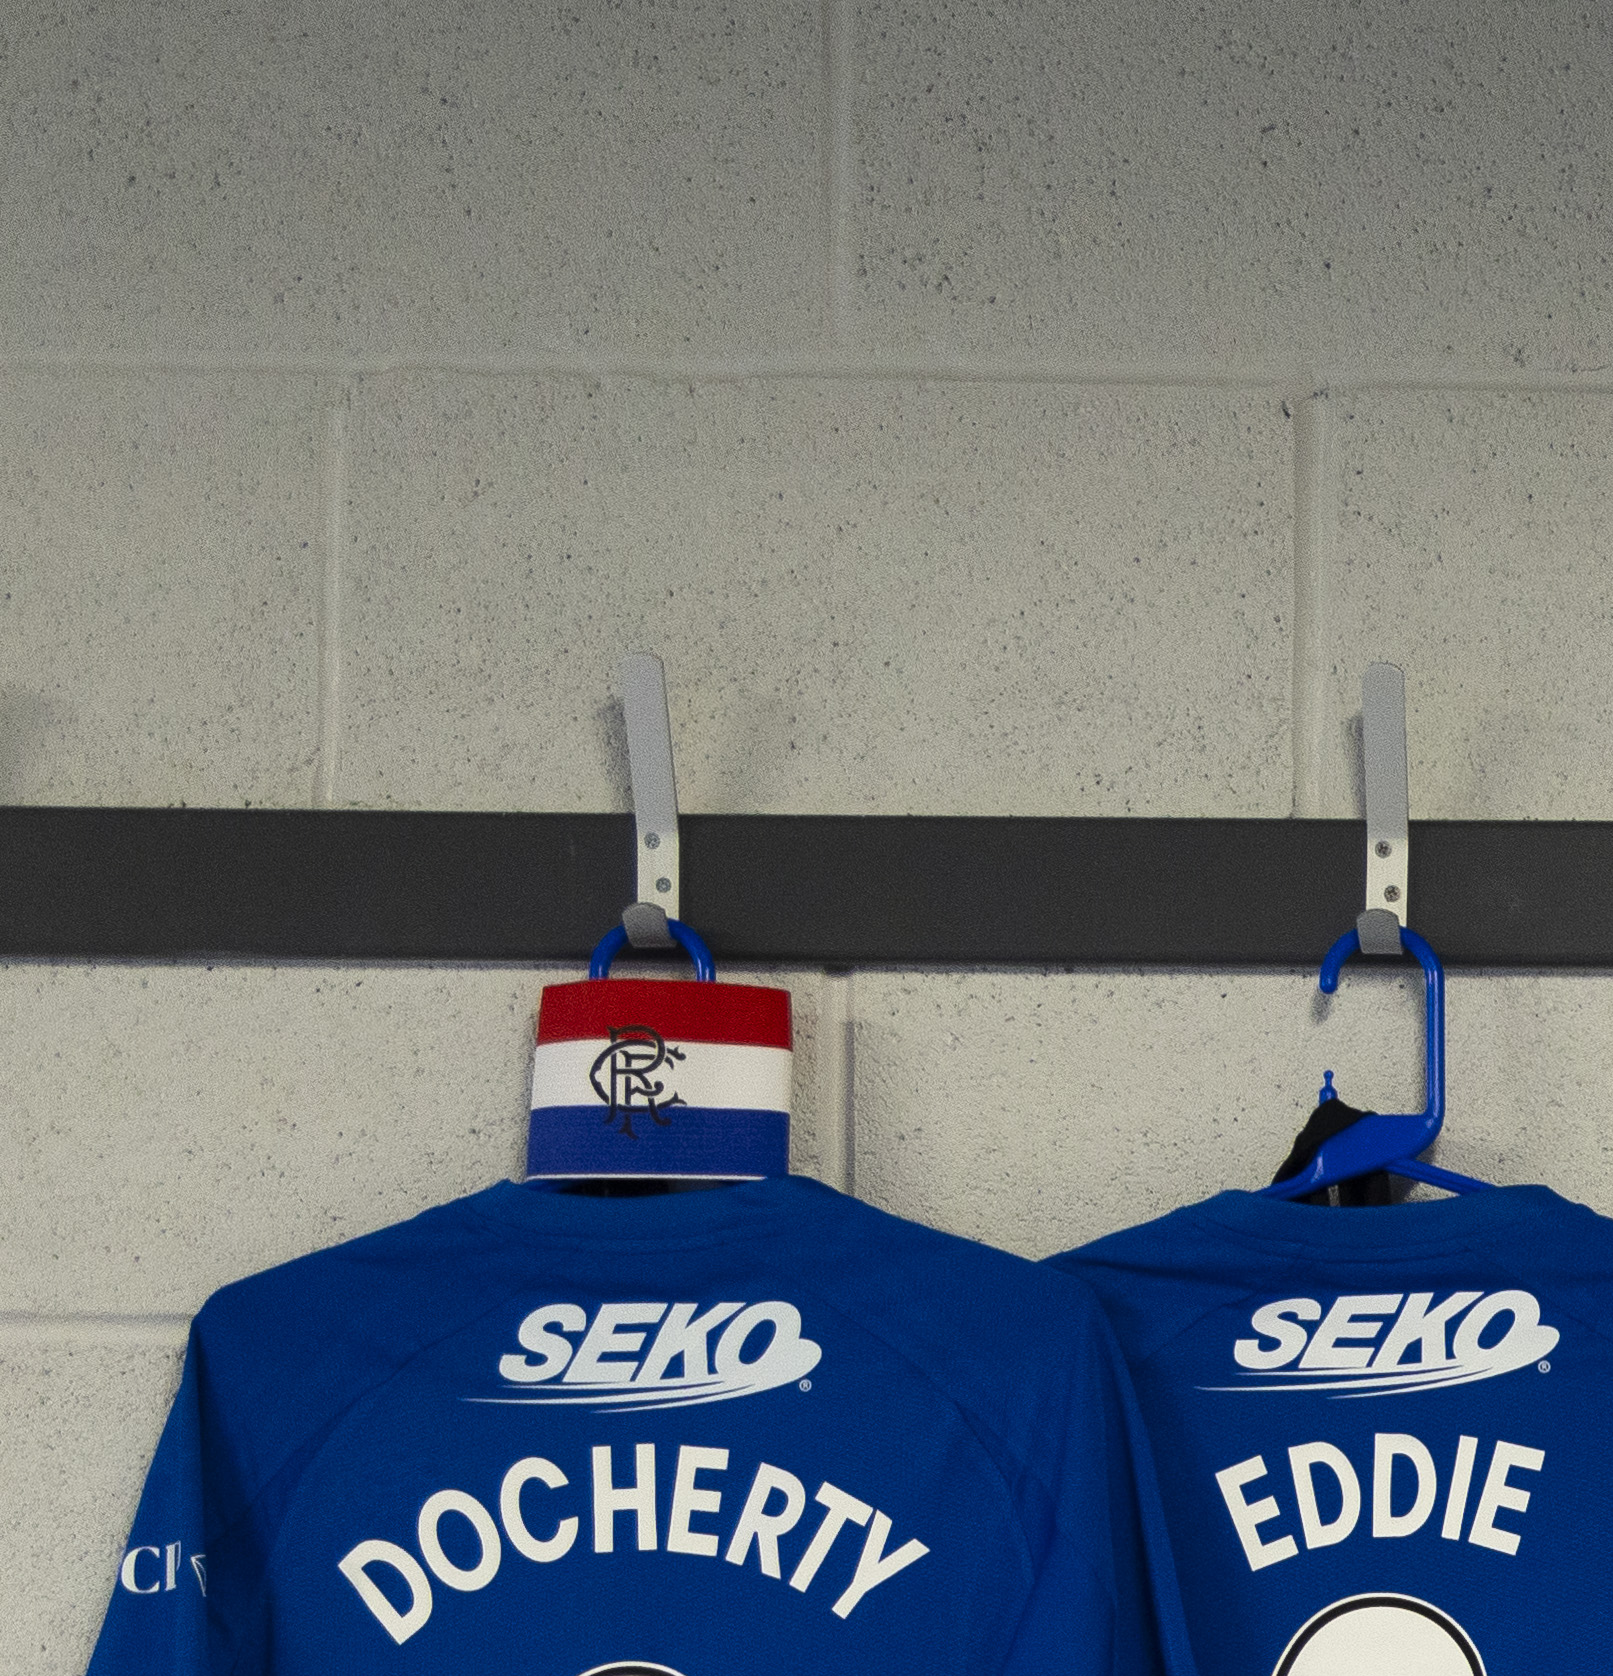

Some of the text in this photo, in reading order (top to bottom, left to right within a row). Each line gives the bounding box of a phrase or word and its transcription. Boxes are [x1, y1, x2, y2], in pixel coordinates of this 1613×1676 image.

[498, 1300, 803, 1384] SEKO
[1234, 1289, 1542, 1372] SEKO
[337, 1442, 931, 1646] DOCHERTY
[1214, 1432, 1546, 1572] EDDIE
